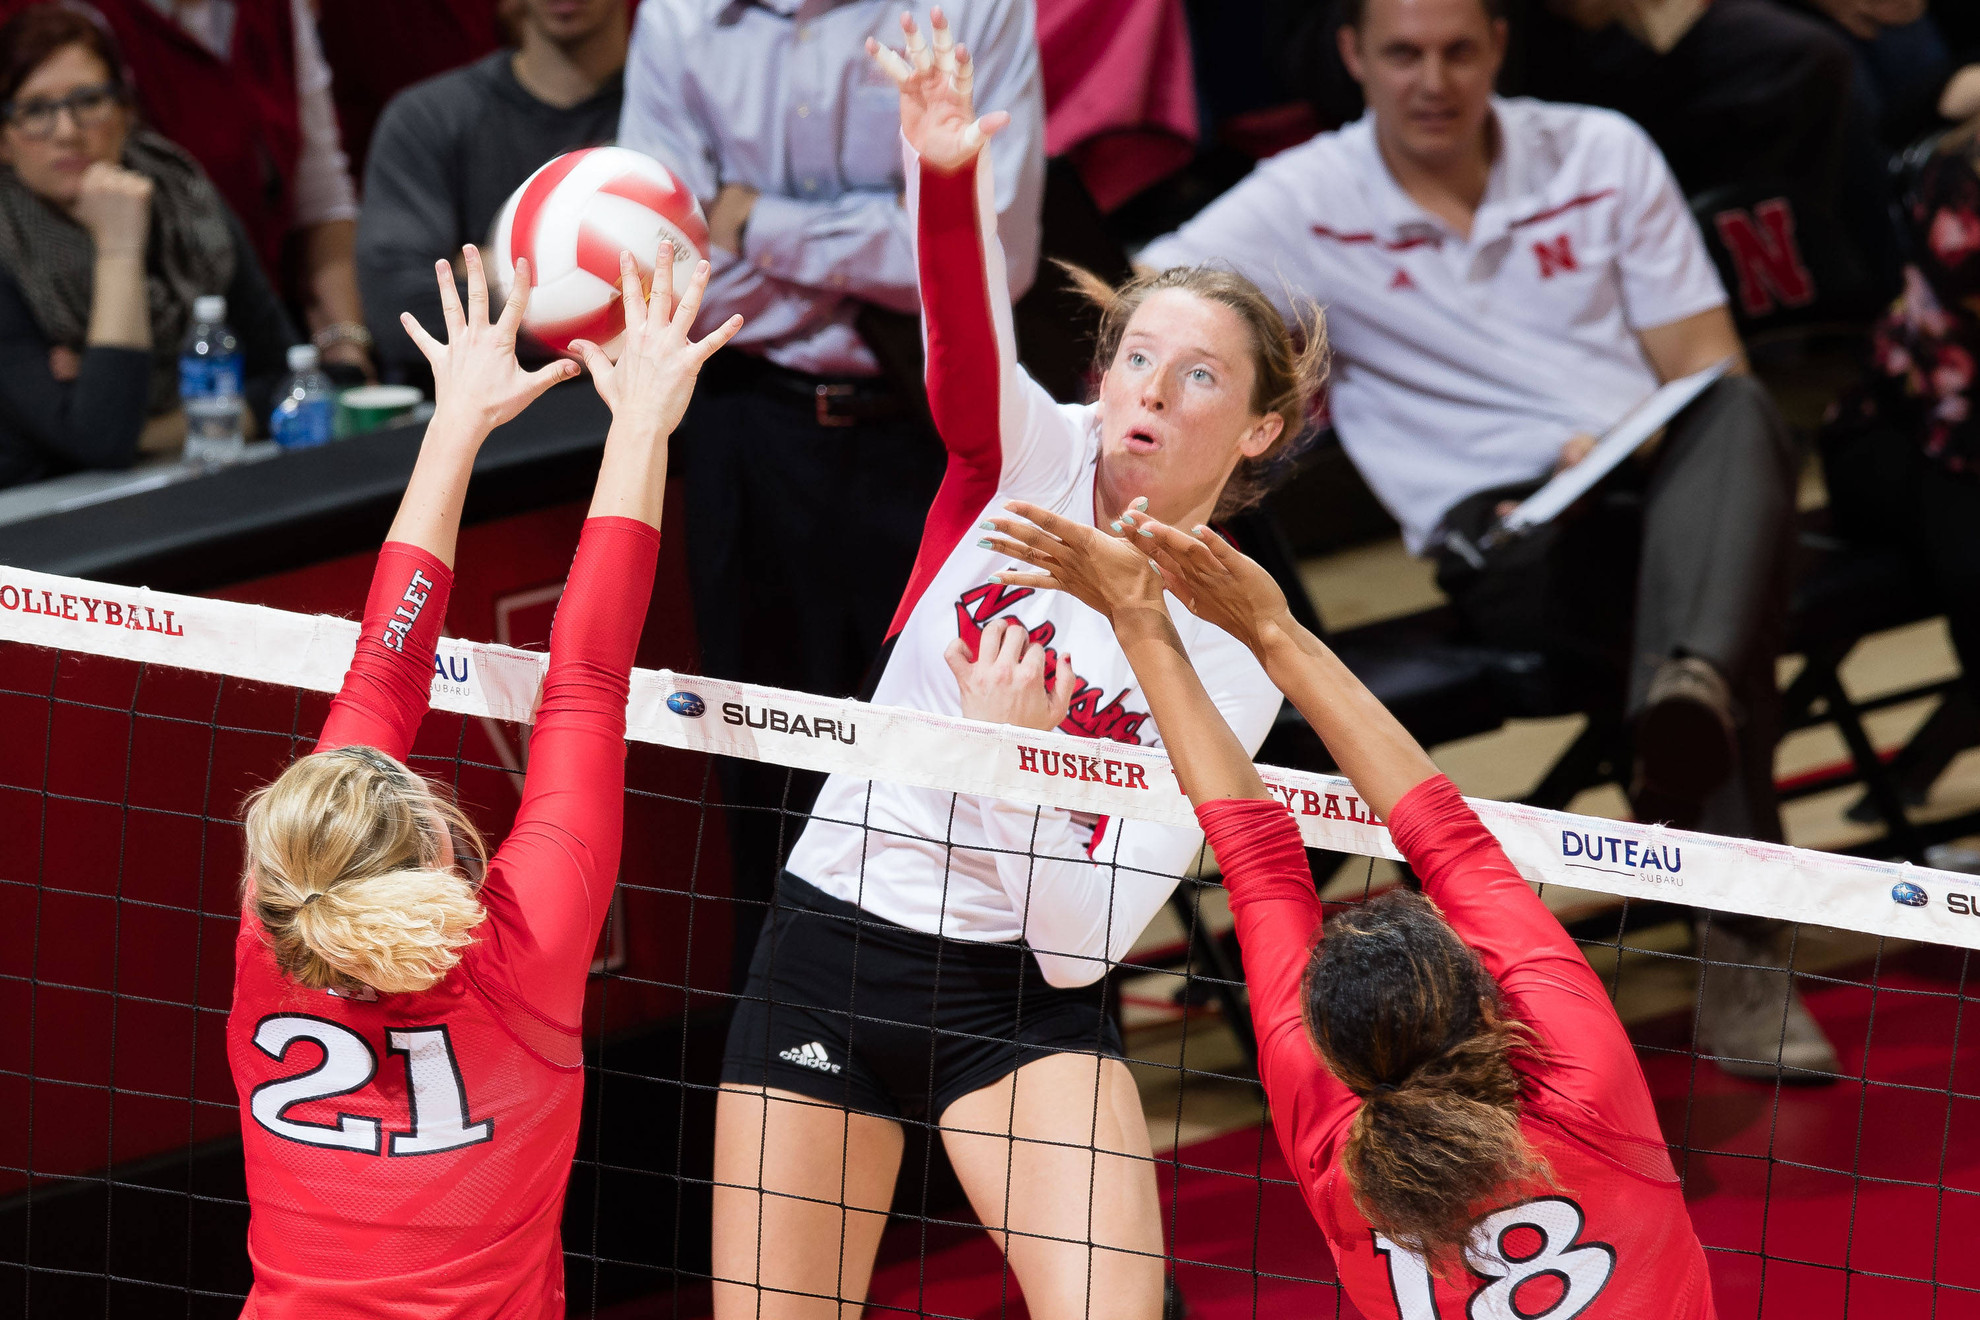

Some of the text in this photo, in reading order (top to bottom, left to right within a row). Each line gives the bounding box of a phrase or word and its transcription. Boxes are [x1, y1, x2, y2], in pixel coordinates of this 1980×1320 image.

[1530, 232, 1578, 280] N
[1714, 197, 1813, 316] N
[382, 568, 433, 653] CALET
[722, 702, 855, 745] SUBARU
[1017, 745, 1149, 790] HUSKER
[1562, 830, 1681, 873] DUTEAU
[1640, 873, 1684, 887] SUBARU
[251, 1011, 495, 1158] 21
[1369, 1195, 1617, 1320] 18
